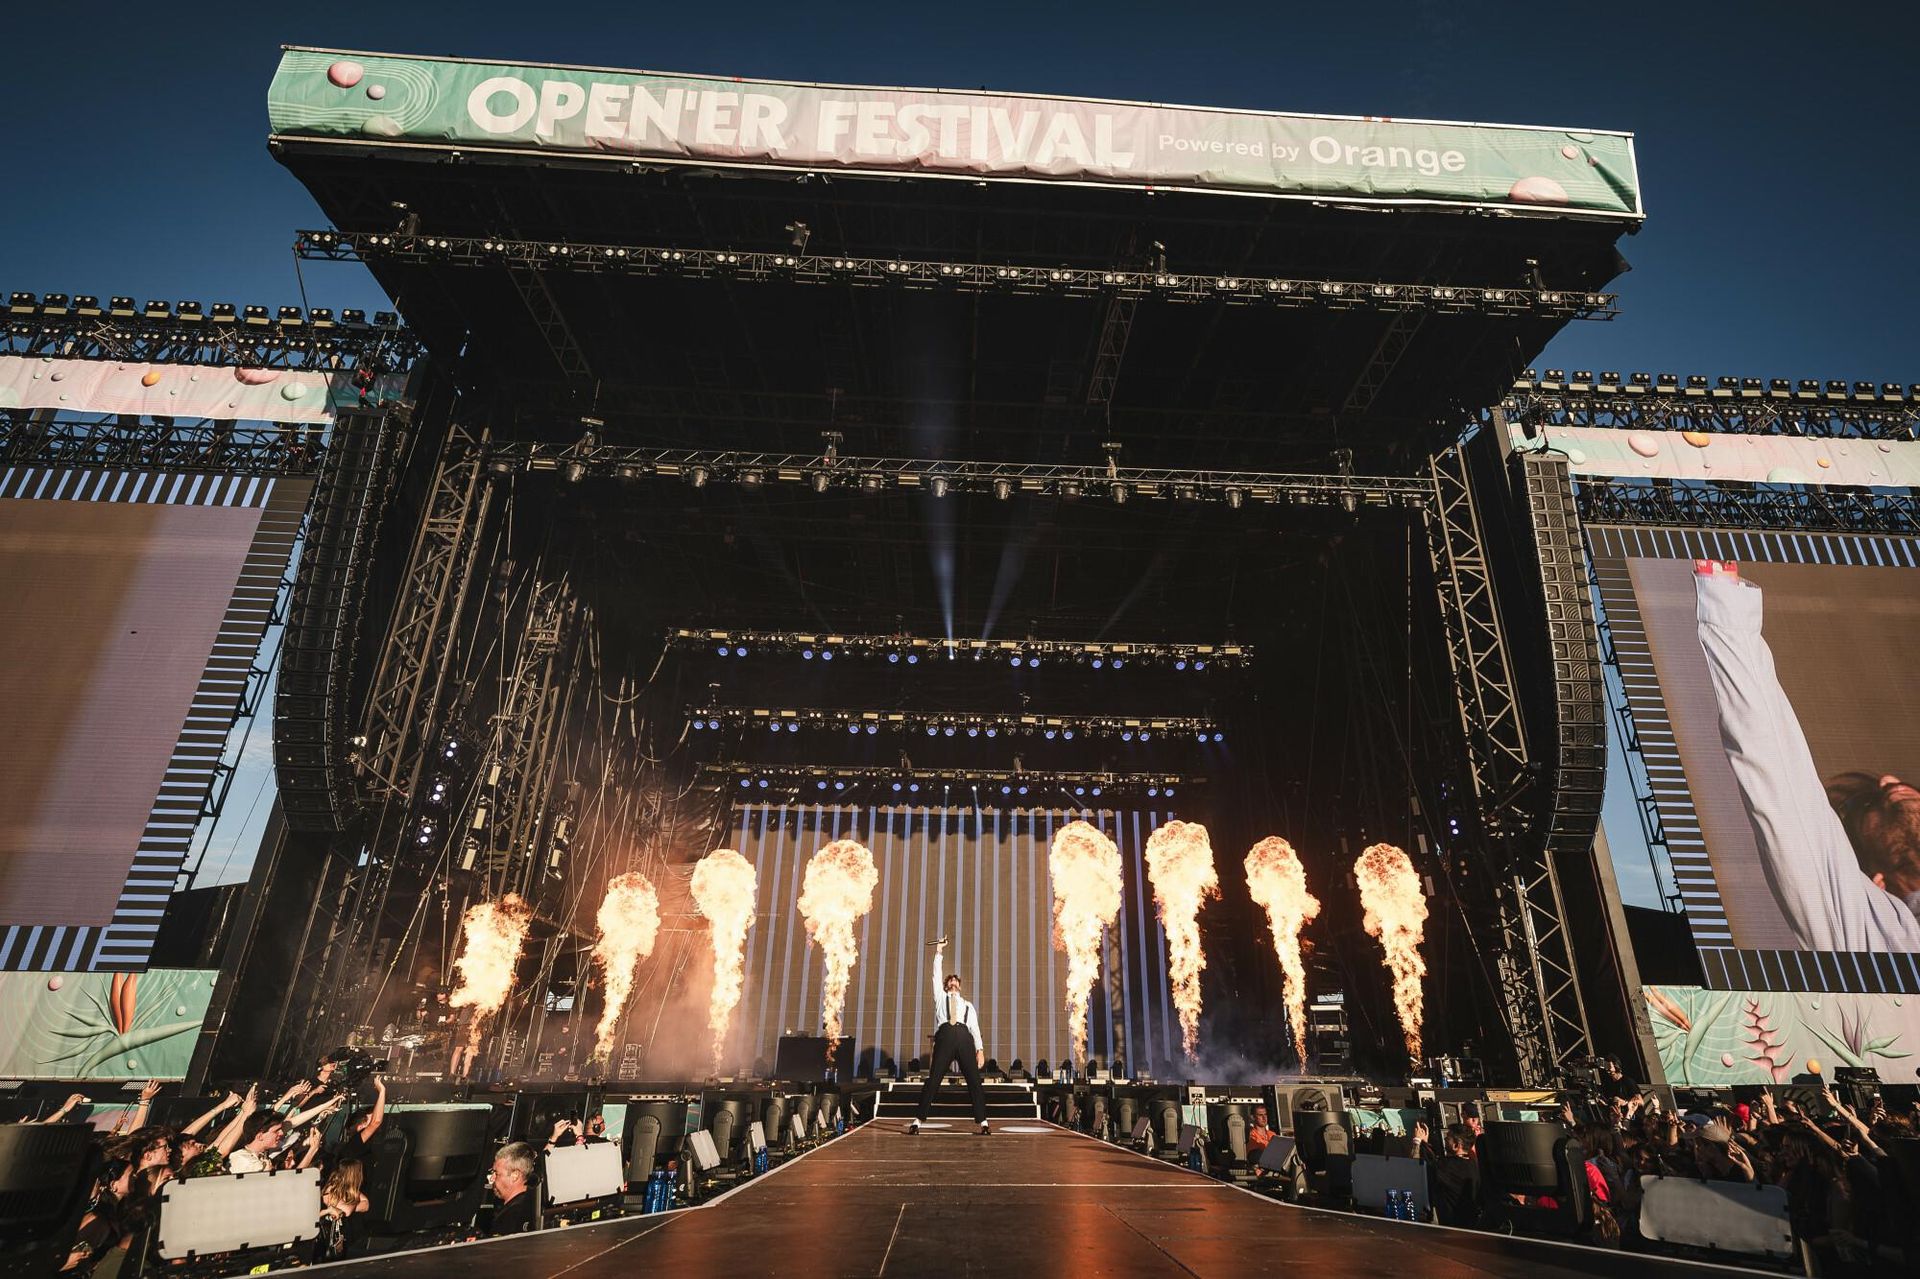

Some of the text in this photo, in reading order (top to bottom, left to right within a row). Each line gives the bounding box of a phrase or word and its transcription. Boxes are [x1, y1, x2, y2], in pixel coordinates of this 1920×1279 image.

[467, 76, 1134, 168] OPEN'ER FESTIVAL
[1158, 134, 1465, 176] Powered by Orange
